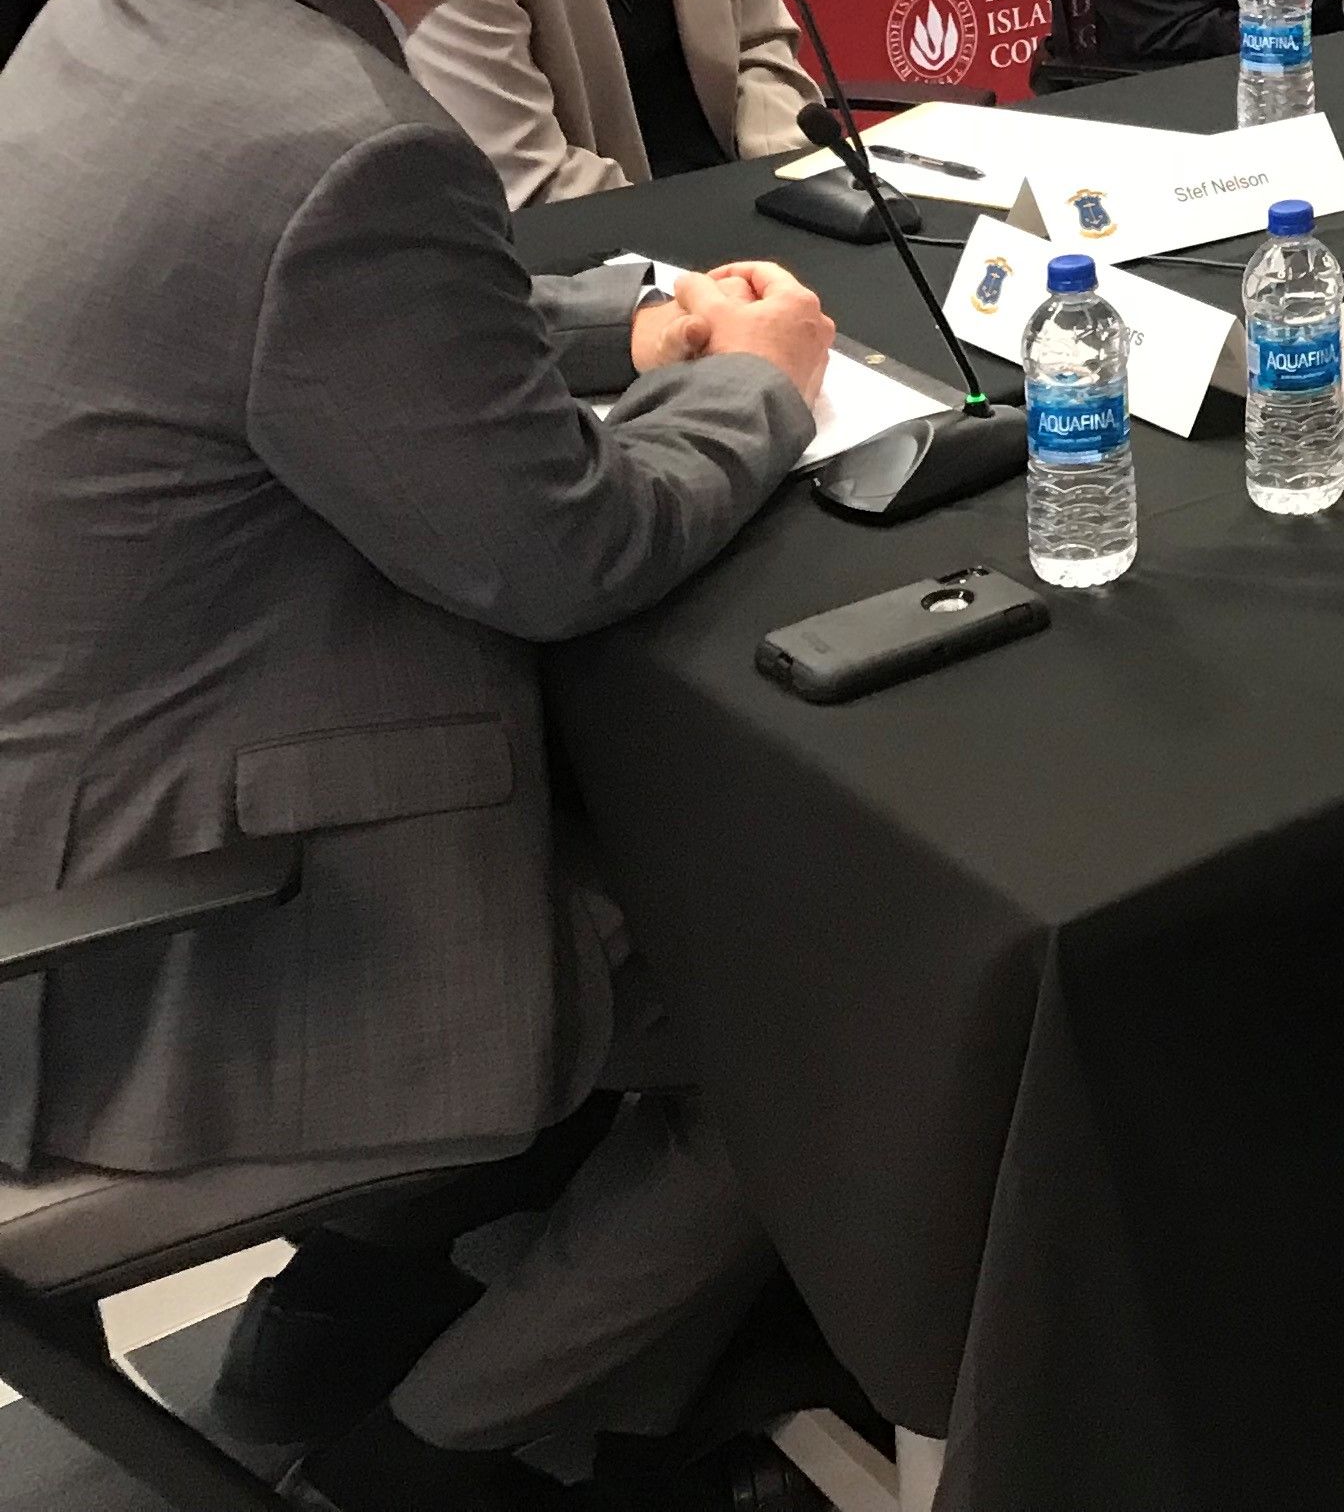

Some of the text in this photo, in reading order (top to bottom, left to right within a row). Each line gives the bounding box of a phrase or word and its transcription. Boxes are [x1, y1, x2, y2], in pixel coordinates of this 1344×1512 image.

[889, 21, 913, 80] RHODE
[1242, 33, 1298, 51] AQUAFINA
[1174, 172, 1270, 202] Stef Nelson
[1266, 343, 1337, 373] AQUAFINA
[1038, 408, 1115, 436] AQUAFINA
